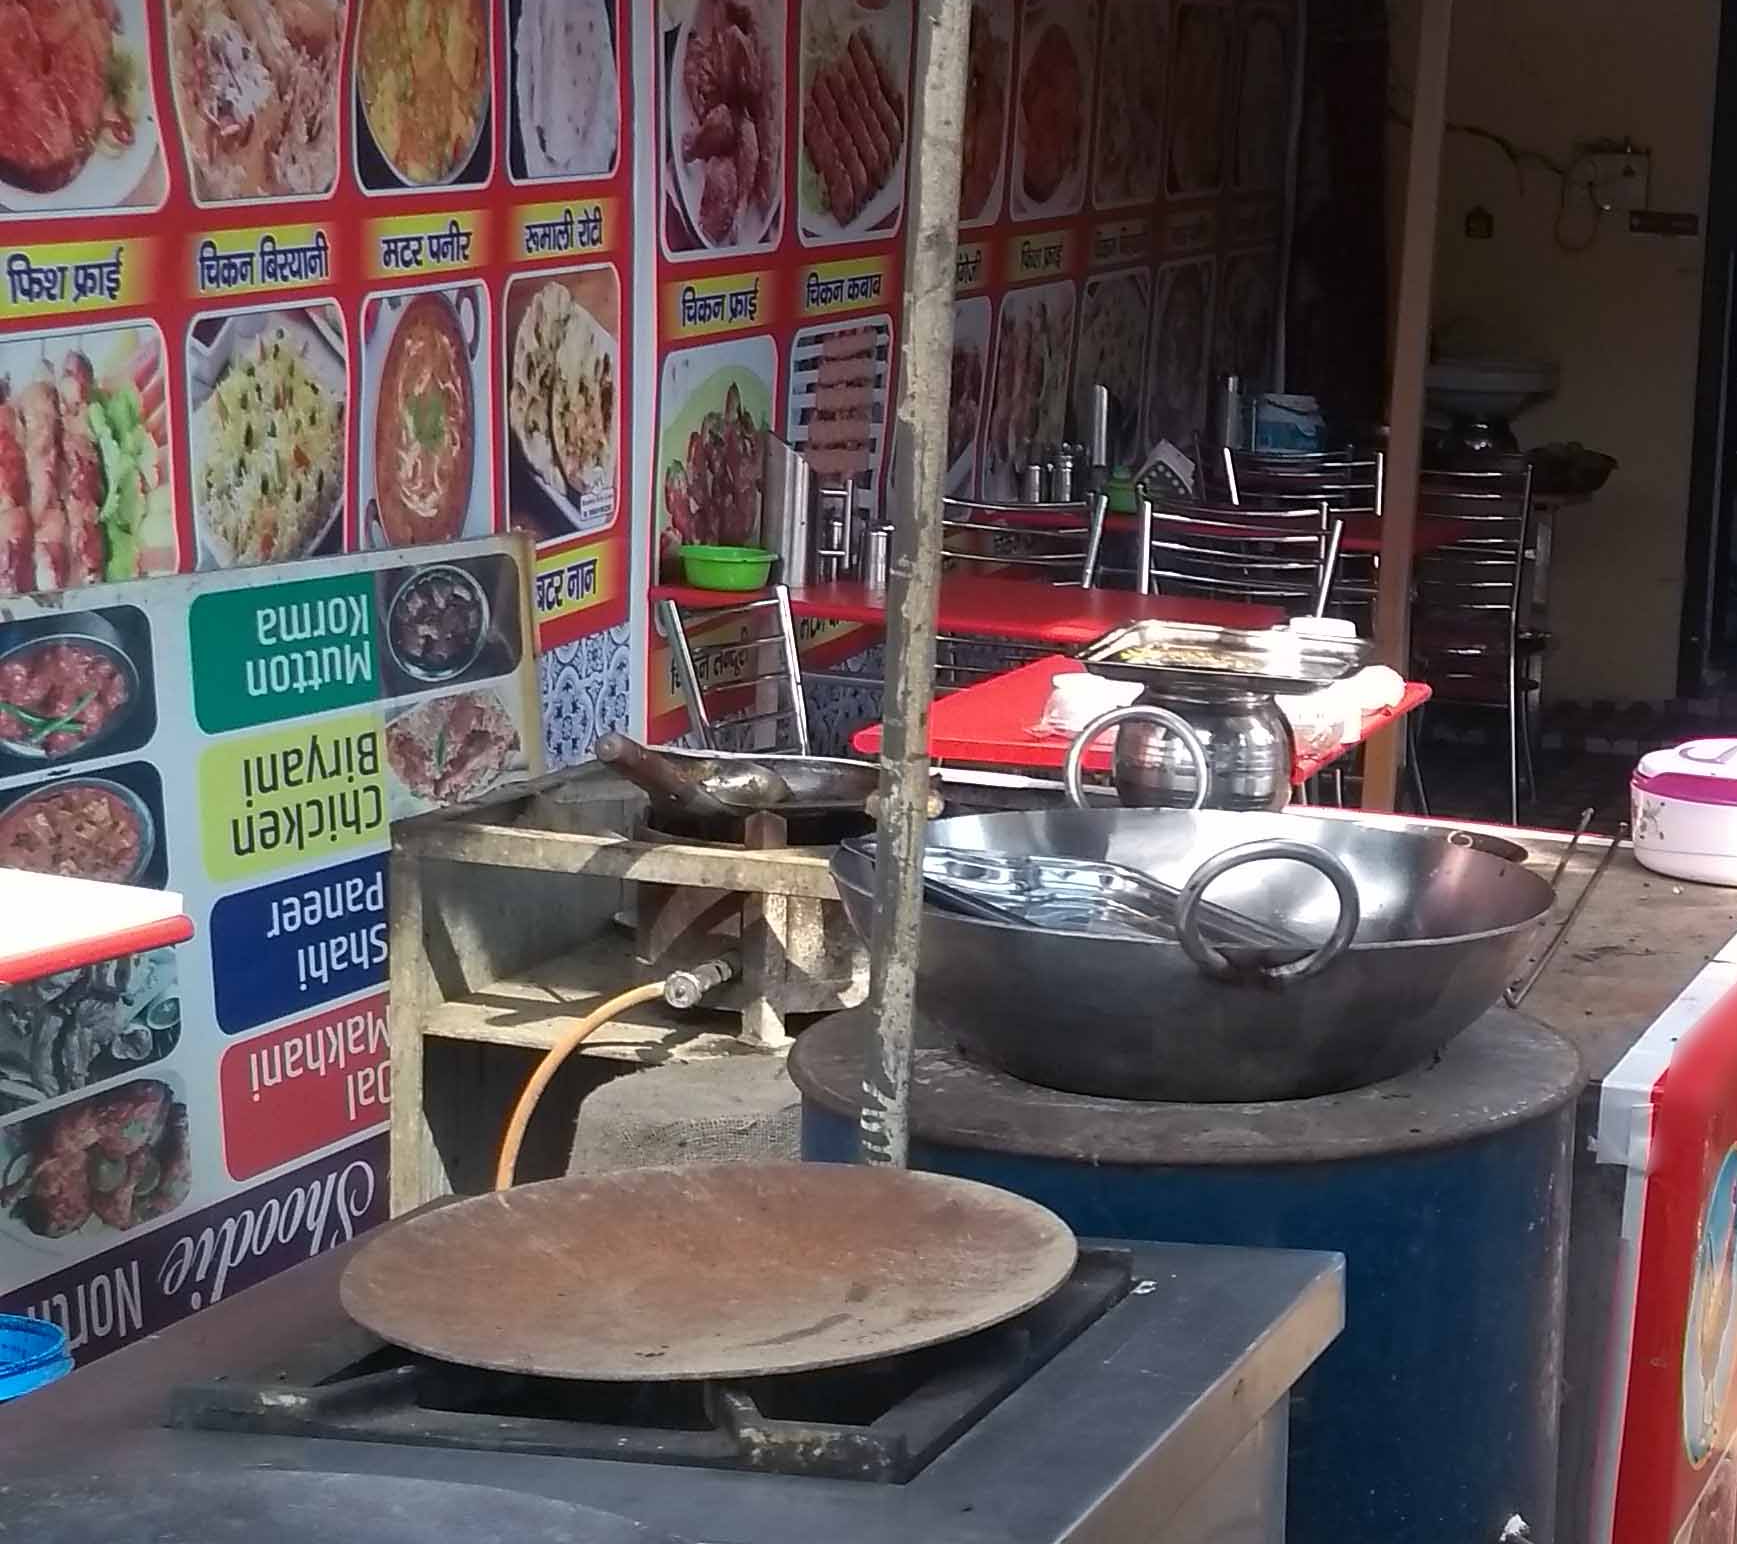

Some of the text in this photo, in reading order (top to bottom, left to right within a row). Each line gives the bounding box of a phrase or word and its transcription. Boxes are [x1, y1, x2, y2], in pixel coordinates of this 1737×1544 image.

[200, 231, 329, 290] चिकन बिरयानी
[382, 220, 473, 268] मटर पनीर
[7, 246, 124, 304] फिश फ्राई
[682, 277, 759, 327] चिकन फ्राई
[807, 272, 881, 308] चिकन कबाब
[566, 558, 598, 600] नान
[256, 593, 370, 646] Korma
[246, 641, 373, 697] Mutton
[243, 732, 379, 808] Biryani
[232, 784, 383, 856] Chicken
[266, 871, 385, 939] Paneer
[298, 923, 389, 991] Shahi
